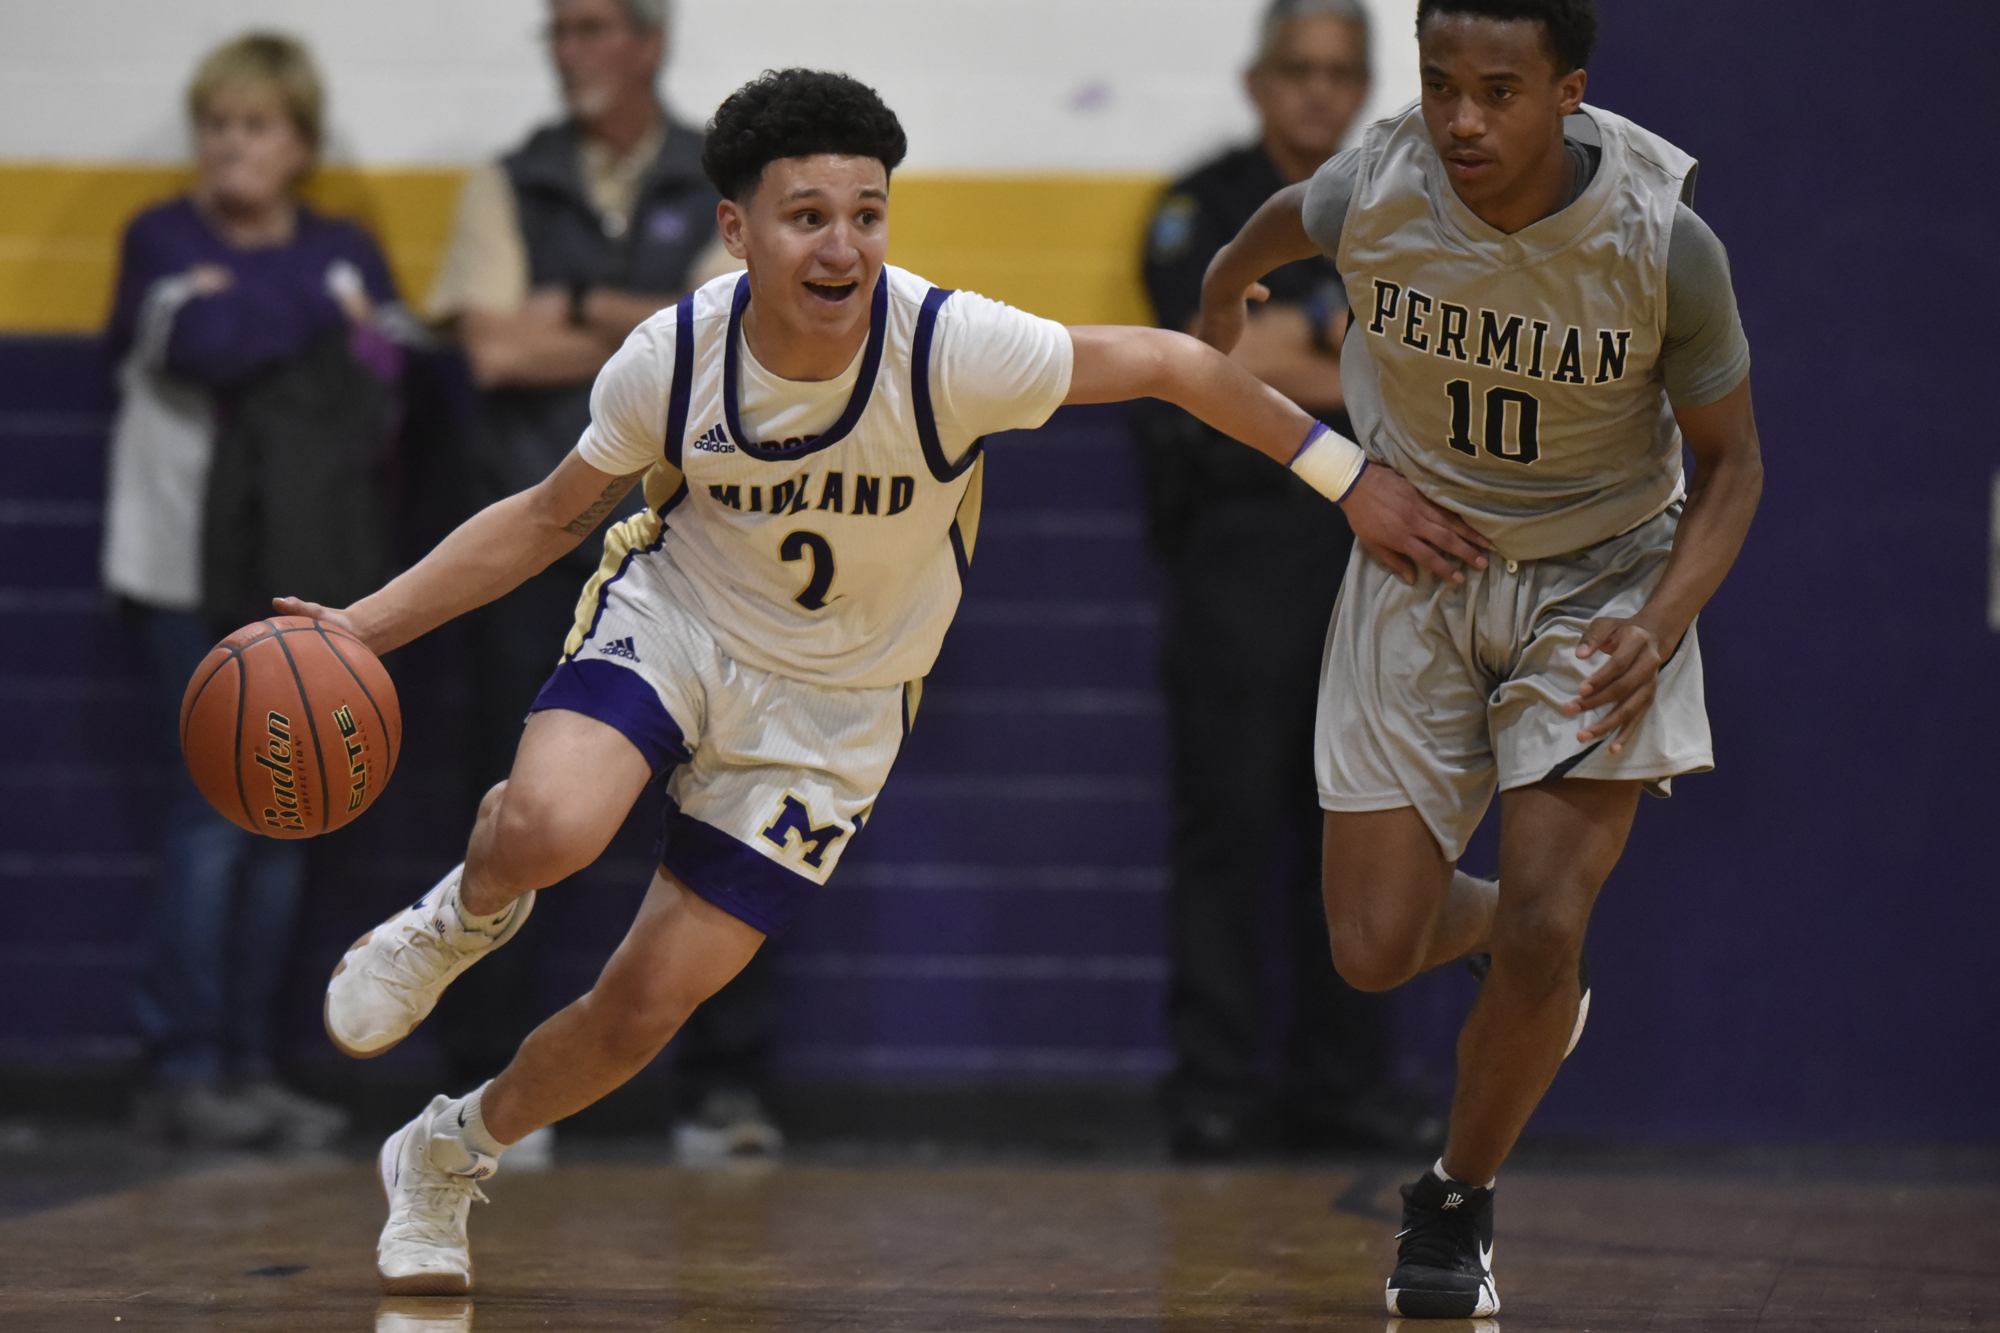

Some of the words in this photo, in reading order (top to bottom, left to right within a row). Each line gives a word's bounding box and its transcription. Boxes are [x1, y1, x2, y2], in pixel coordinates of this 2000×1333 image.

[1367, 276, 1633, 386] PERMIAN
[694, 438, 736, 454] adidas
[1444, 377, 1541, 466] 10
[708, 470, 916, 517] MIDLAND
[777, 528, 845, 612] 2
[599, 646, 642, 664] adidas
[254, 710, 306, 831] Baden
[294, 738, 313, 817] PERFECTION
[332, 704, 367, 814] ELITE
[755, 787, 848, 875] M
